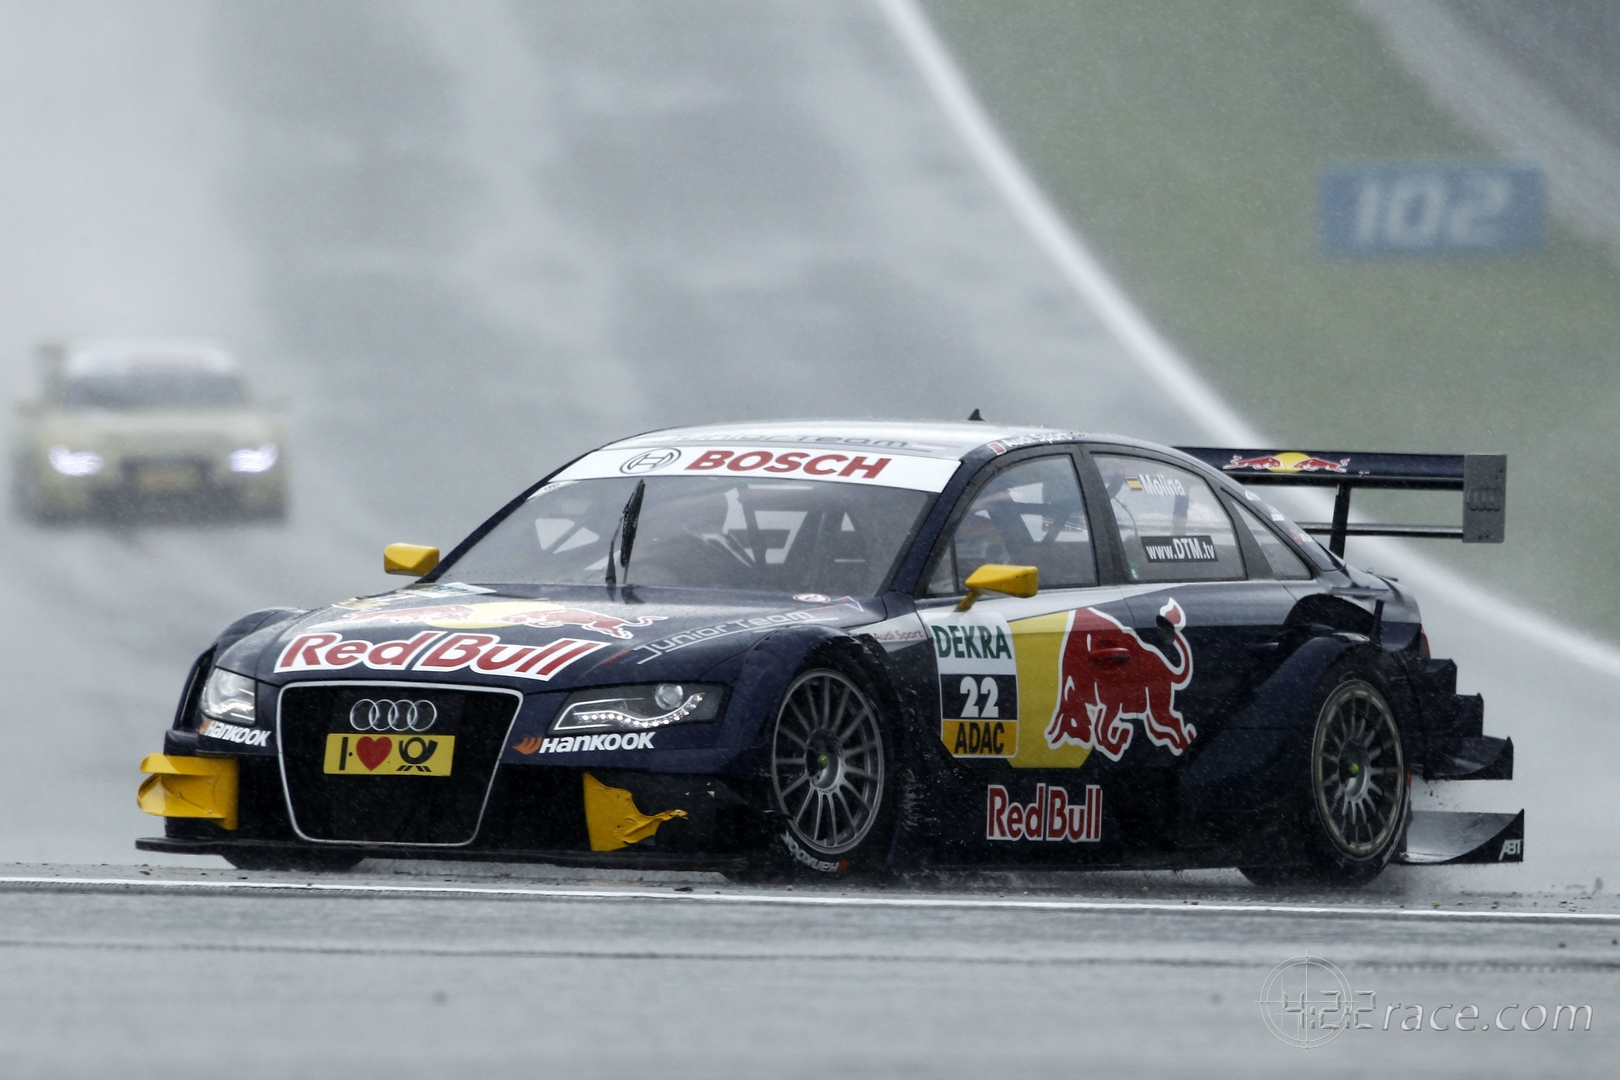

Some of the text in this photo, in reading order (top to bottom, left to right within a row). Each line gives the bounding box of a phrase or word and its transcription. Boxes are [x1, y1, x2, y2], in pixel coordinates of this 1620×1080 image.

[1353, 176, 1512, 246] 102
[684, 450, 892, 479] BOSCH
[1139, 474, 1187, 496] Molina
[1145, 537, 1216, 560] www.DTM.tv
[873, 629, 924, 641] Audi Sport
[931, 625, 1013, 660] DEKRA
[274, 631, 612, 681] Red Bull
[959, 676, 999, 718] 22
[953, 721, 1005, 755] ADAC
[986, 783, 1103, 843] Red Bull
[1498, 839, 1523, 861] ABT
